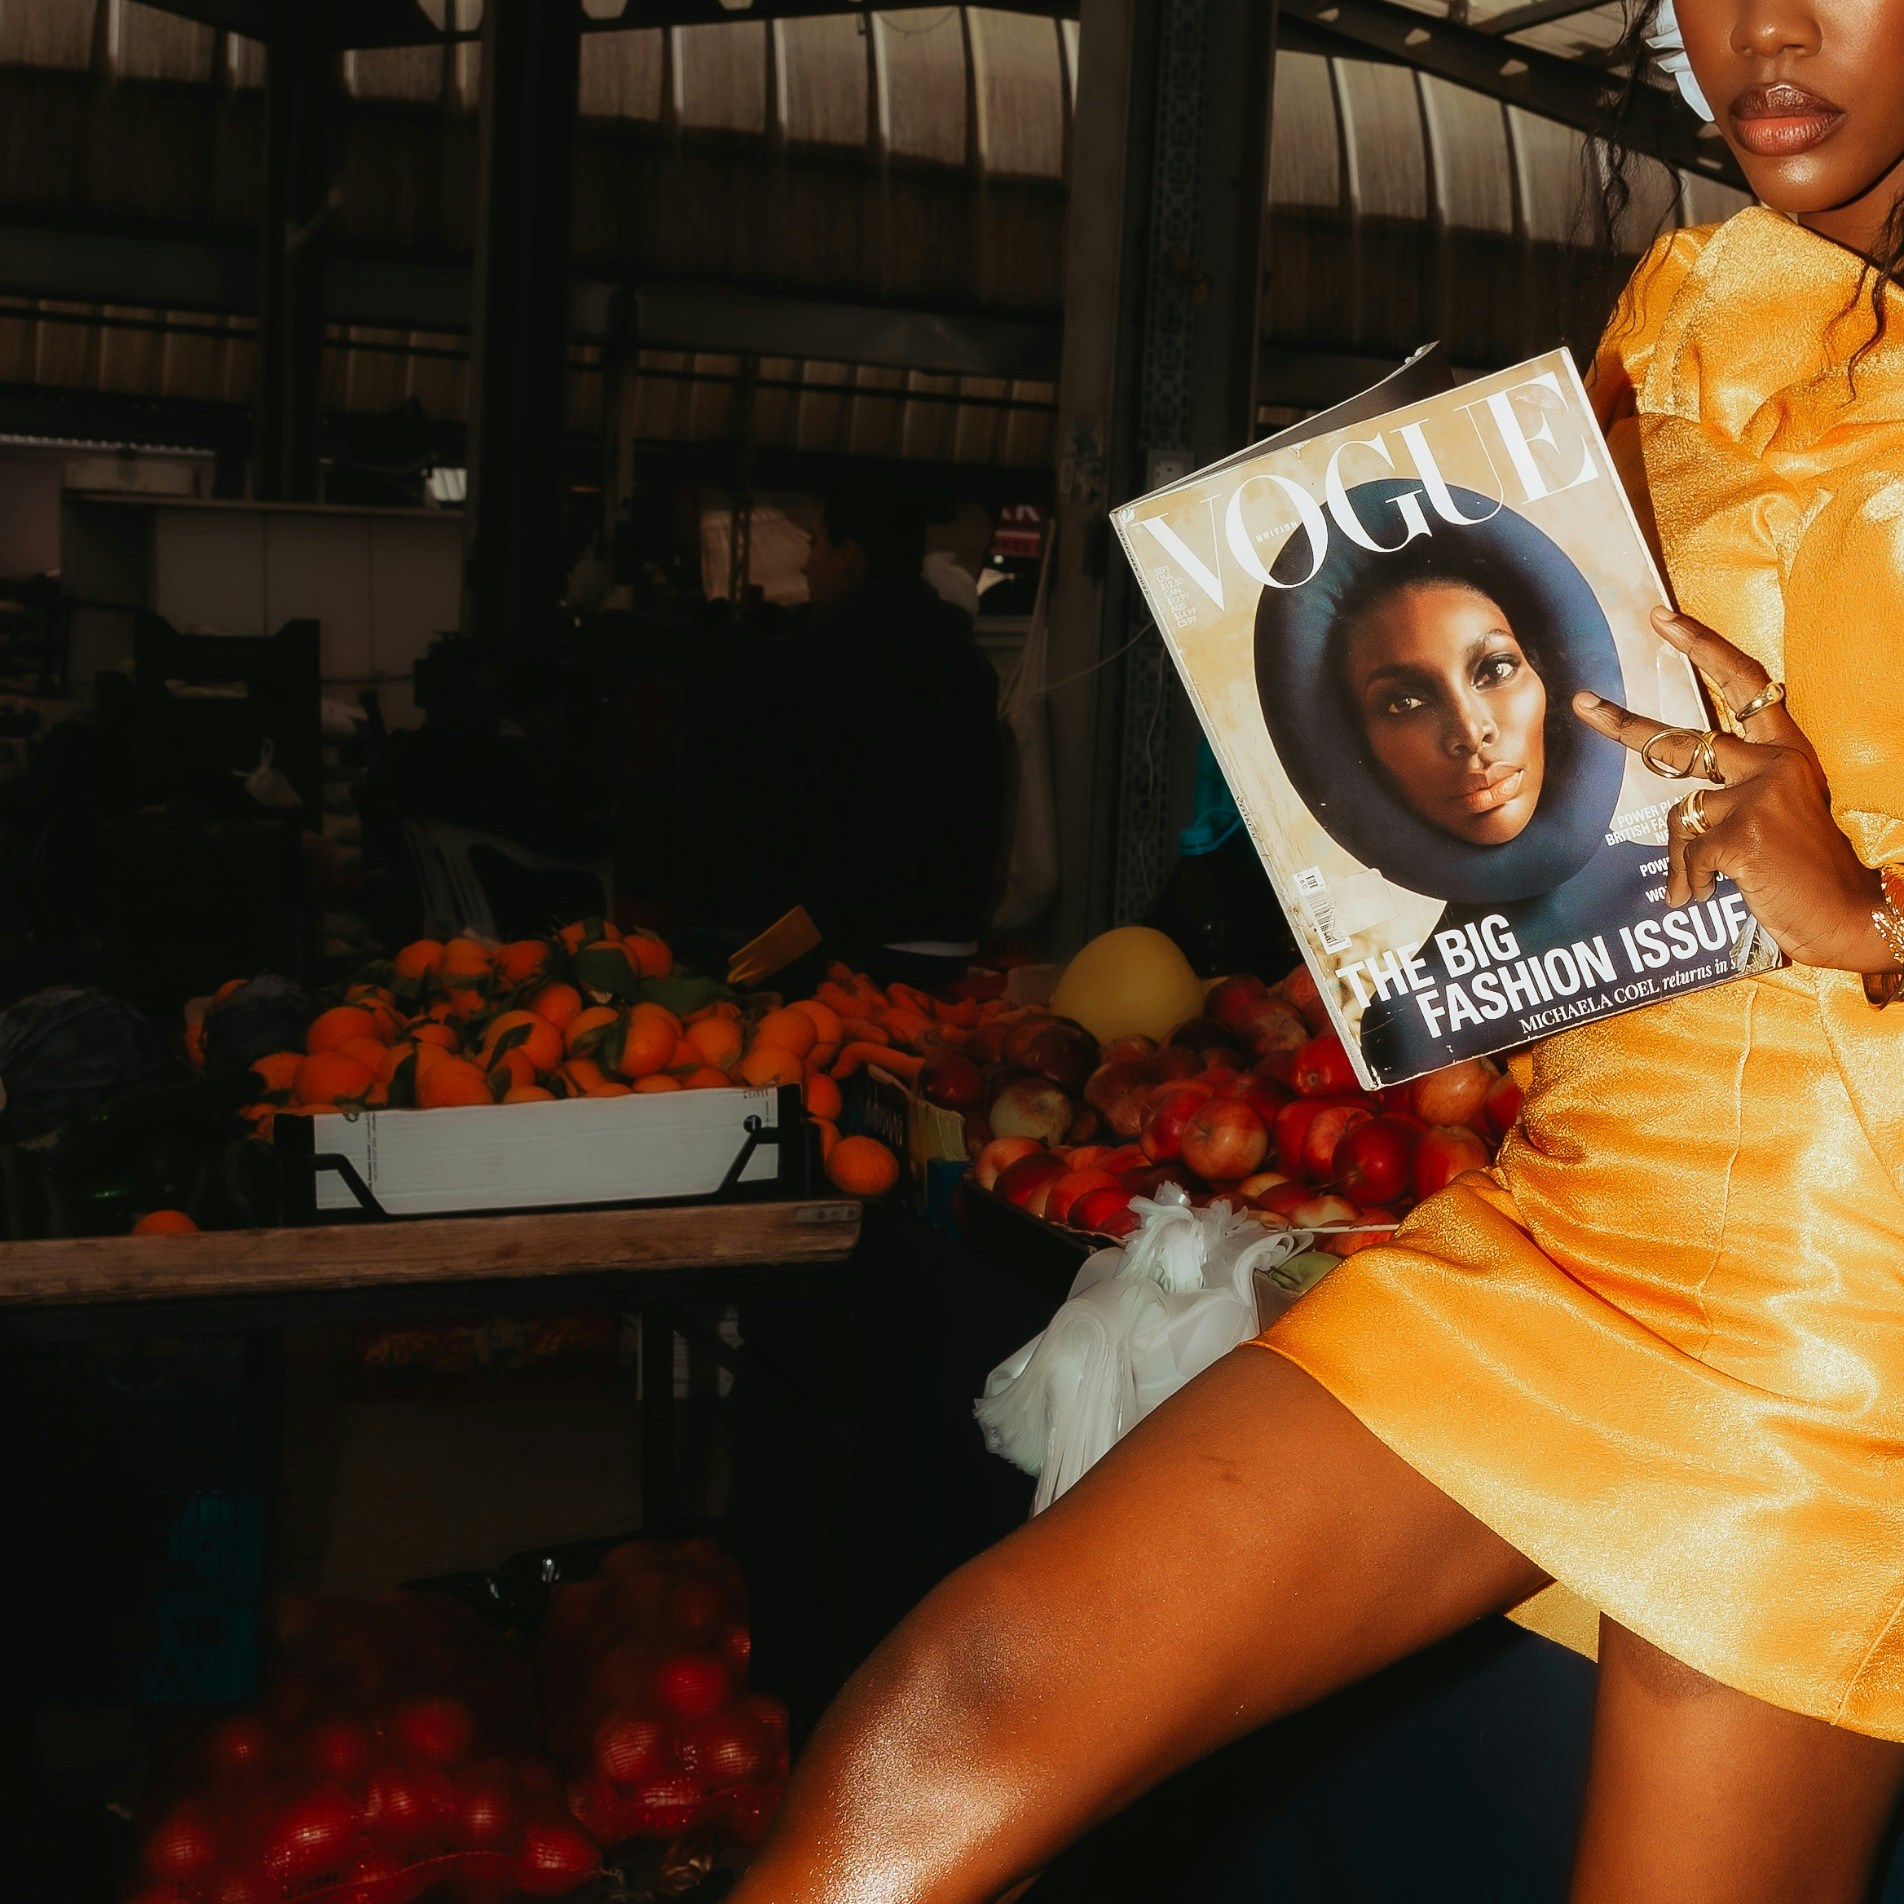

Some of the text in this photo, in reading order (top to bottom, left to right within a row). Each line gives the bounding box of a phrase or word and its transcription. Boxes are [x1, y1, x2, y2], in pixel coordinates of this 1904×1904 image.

[1132, 371, 1599, 612] VOGUE
[1256, 521, 1298, 543] BRITISH
[1604, 821, 1652, 847] BRITISH
[1616, 804, 1660, 829] POWER
[1336, 913, 1522, 1010] THE BIG
[1415, 935, 1618, 1038] FASHION
[1519, 997, 1614, 1034] MICHAELA
[1614, 978, 1661, 1004] COEL
[1661, 962, 1713, 991] returns
[1714, 958, 1729, 976] in
